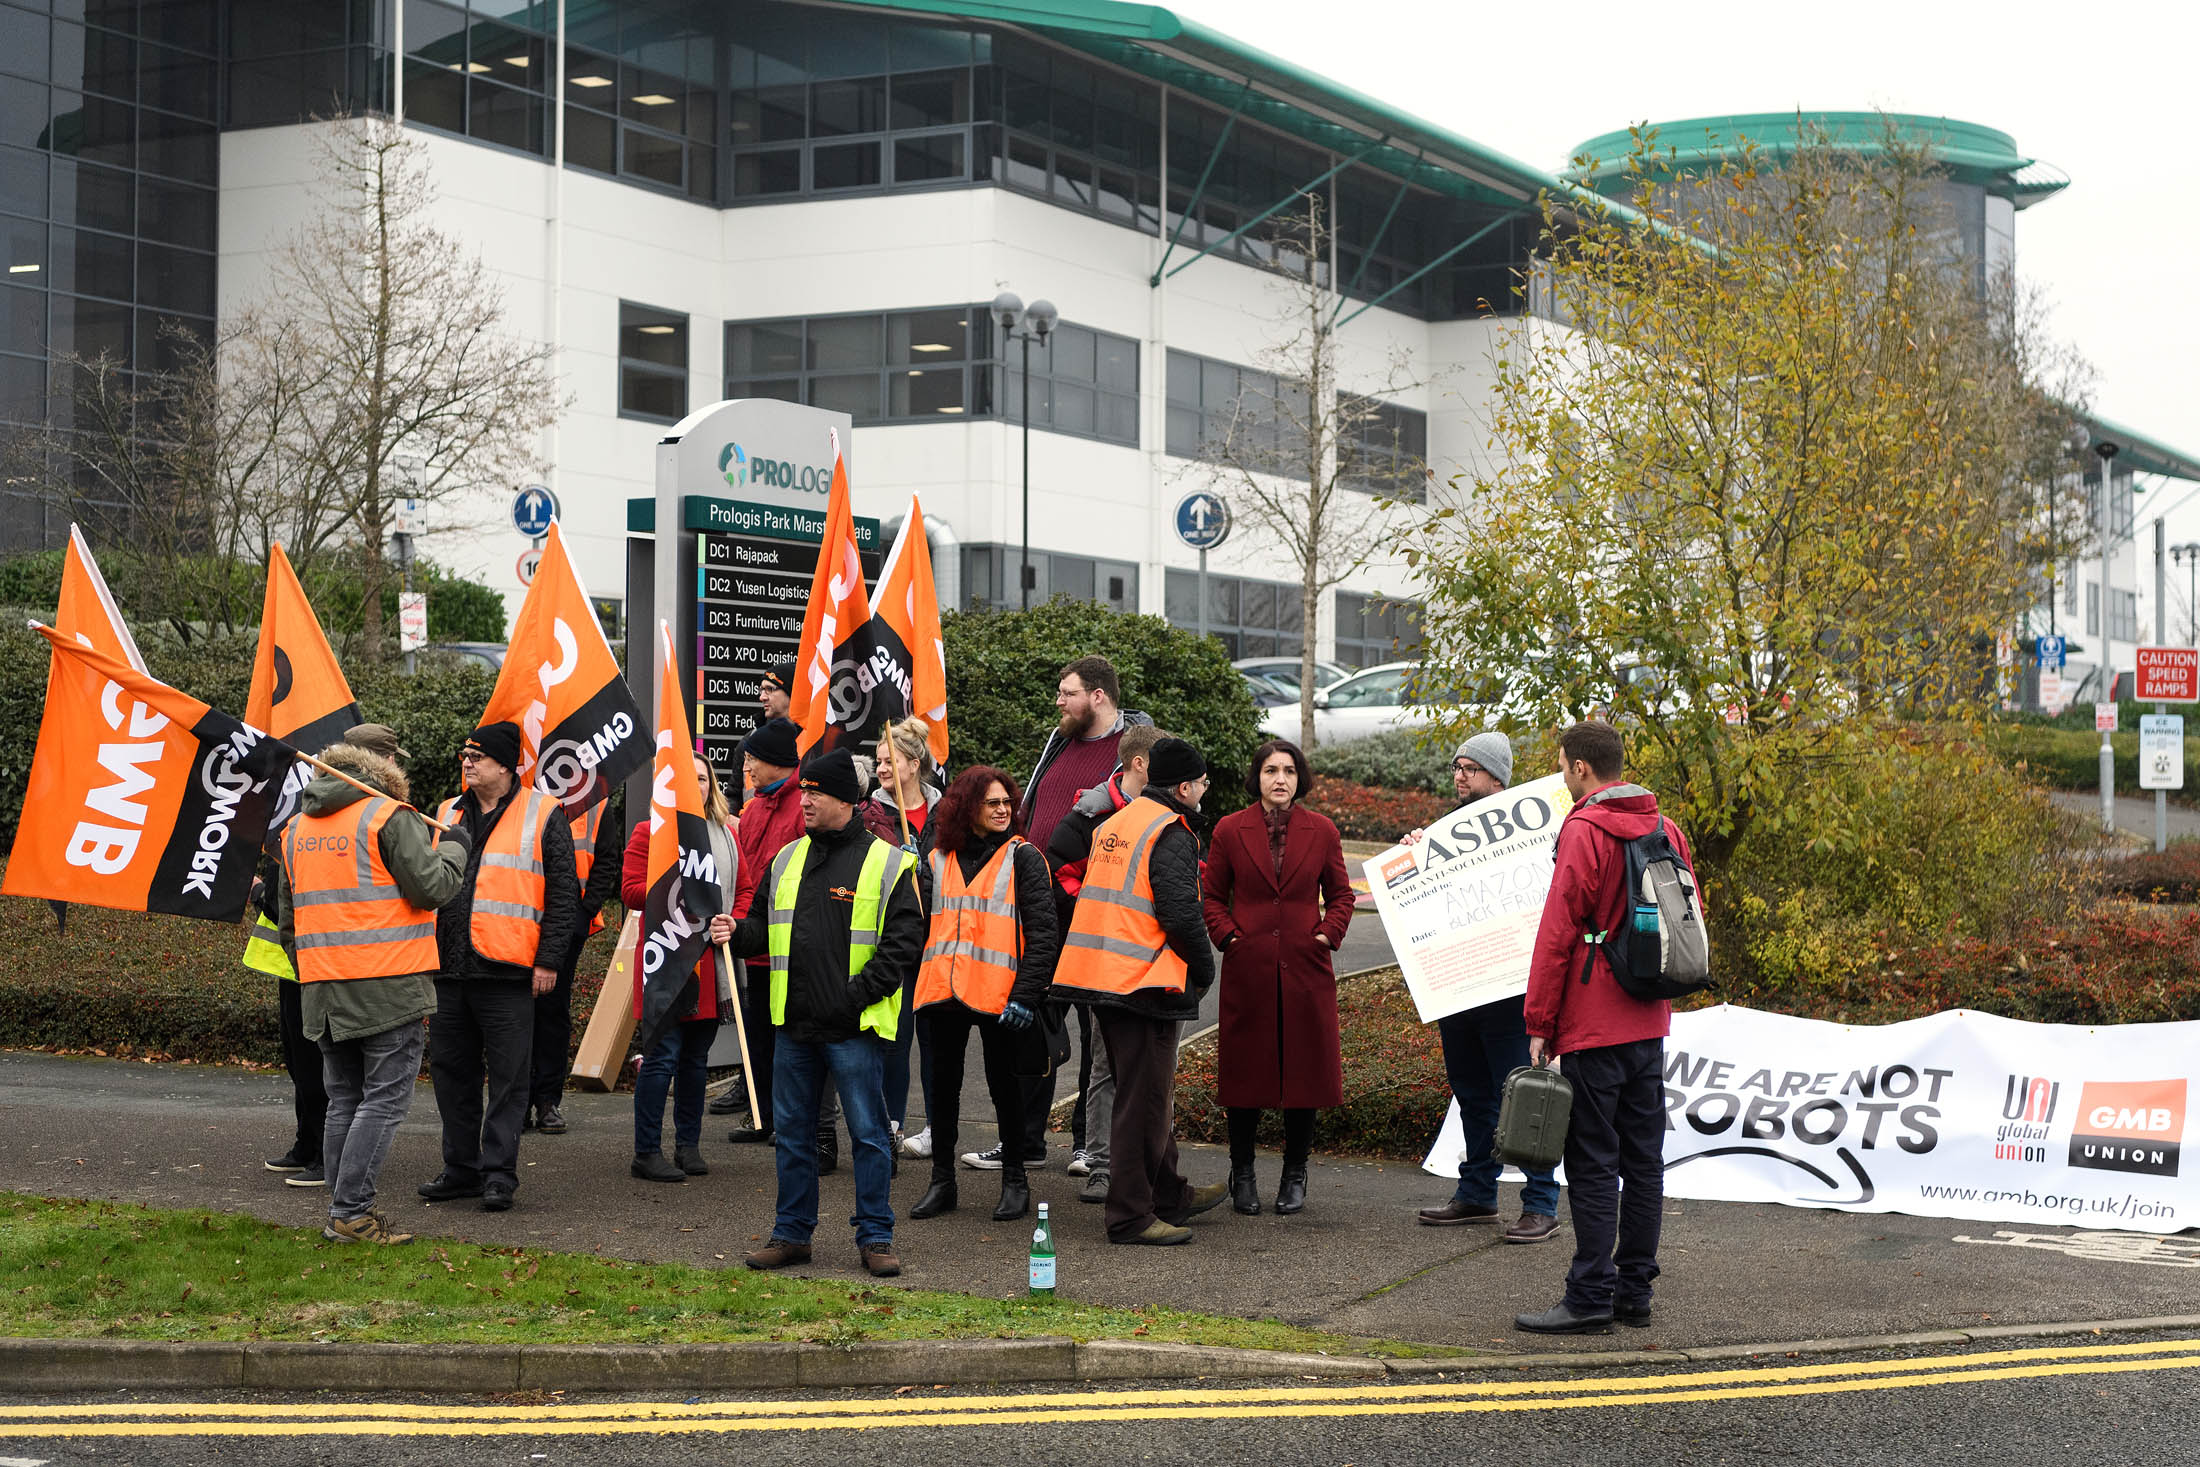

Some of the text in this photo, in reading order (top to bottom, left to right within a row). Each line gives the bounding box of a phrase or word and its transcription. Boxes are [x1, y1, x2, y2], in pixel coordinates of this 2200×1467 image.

[751, 456, 833, 495] PROLOGI
[710, 504, 872, 541] Prologis Park Mars ate
[709, 543, 779, 564] DC1 Rajapack
[709, 577, 810, 600] DC2 Yusen Logistics
[709, 611, 804, 632] DC3 Furniture Villa
[709, 645, 798, 667] DC4 XPO Logisti
[2139, 651, 2197, 667] CAUTION
[2148, 667, 2188, 681] SPEED
[709, 679, 759, 695] DC5 Wols
[2145, 682, 2188, 696] RAMPS
[709, 713, 756, 729] DC6 Fed
[708, 747, 729, 762] DC7
[297, 836, 349, 852] serco
[1423, 797, 1551, 872] ASBO
[1392, 884, 1417, 900] GMB
[1420, 854, 1491, 886] ANTI-SOCIAL
[1446, 857, 1554, 914] AMAZON
[1399, 885, 1438, 908] Awarded
[1501, 887, 1548, 913] FRIDA
[1411, 929, 1437, 943] Date:
[1664, 1051, 1953, 1102] WE ARE NOT
[2088, 1106, 2172, 1131] GMB
[1998, 1122, 2050, 1142] global
[1995, 1140, 2045, 1163] union
[2084, 1144, 2164, 1165] UNION
[1920, 1184, 2175, 1219] www.gmb.org.uk/join
